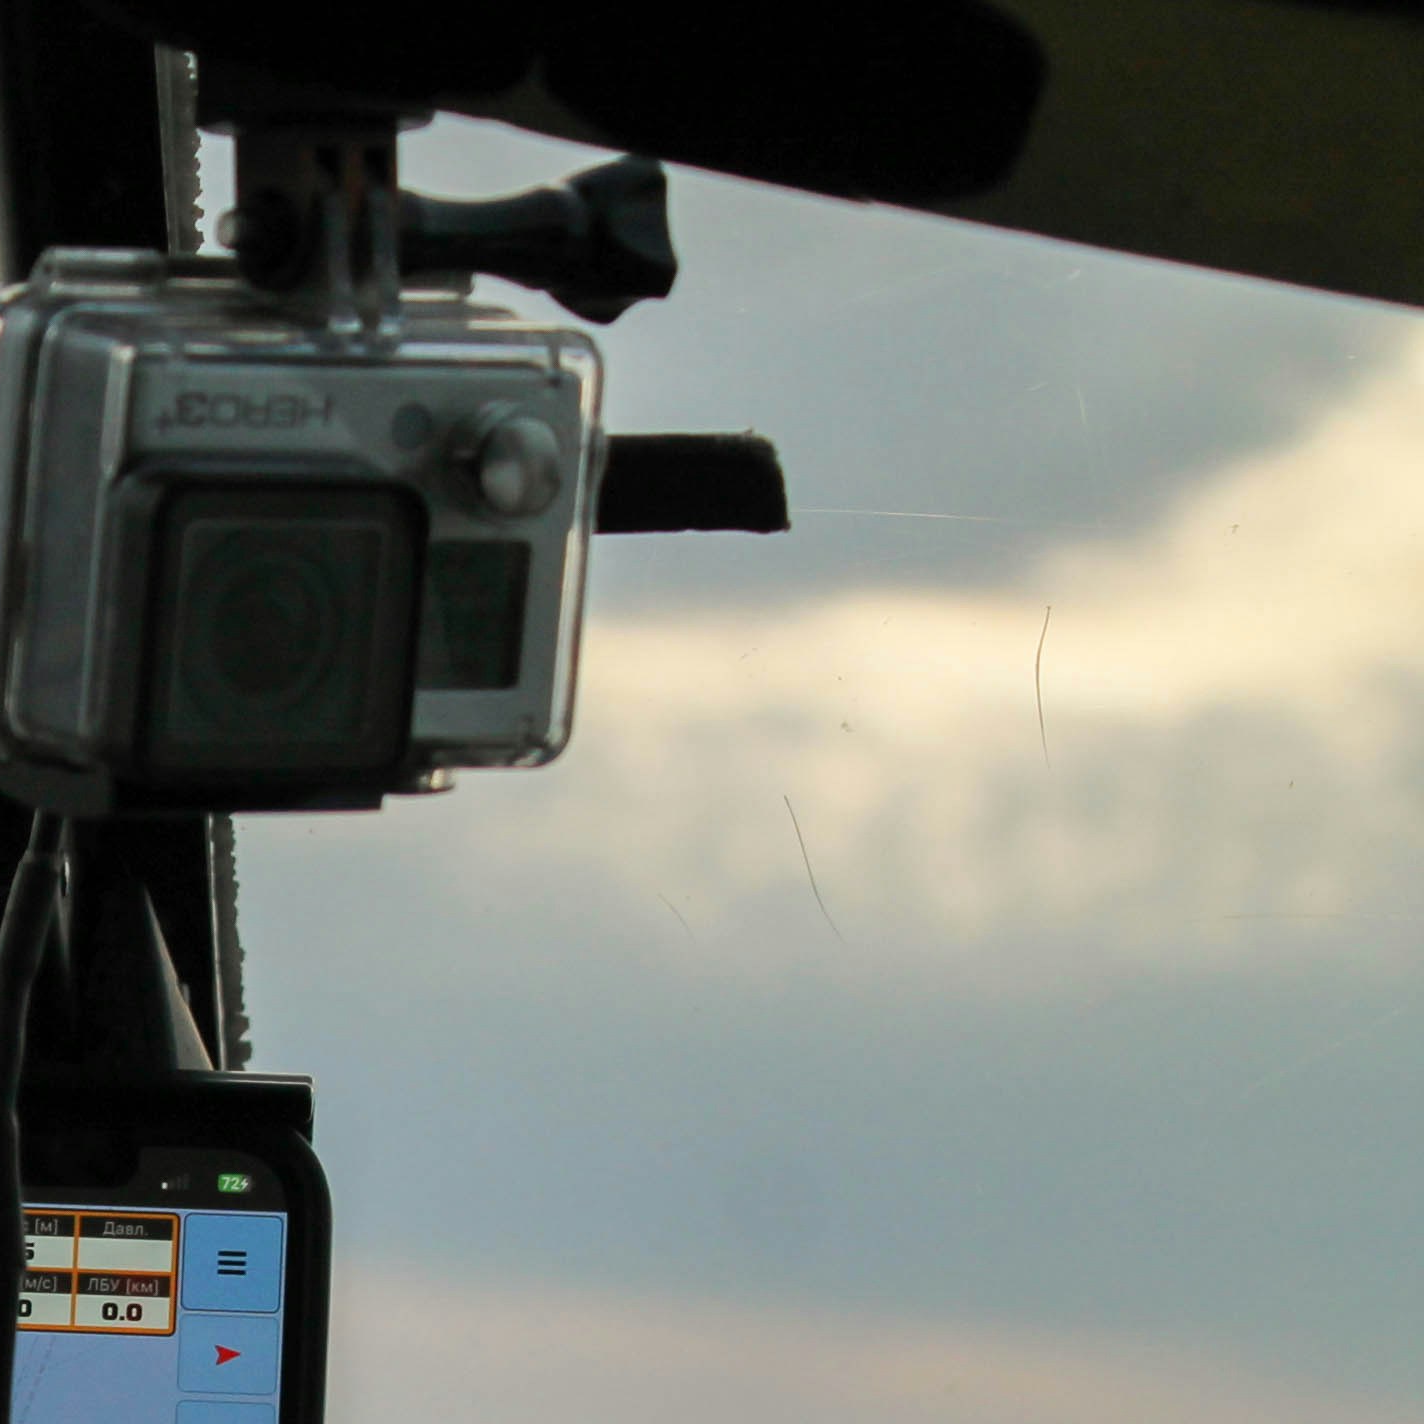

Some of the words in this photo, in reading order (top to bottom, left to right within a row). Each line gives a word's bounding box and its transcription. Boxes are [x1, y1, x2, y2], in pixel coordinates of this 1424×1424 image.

[221, 1176, 241, 1191] 72
[103, 1221, 149, 1236] Давл.
[87, 1279, 119, 1294] ЛБУ
[125, 1280, 160, 1296] [км]
[101, 1301, 144, 1321] 0.0
